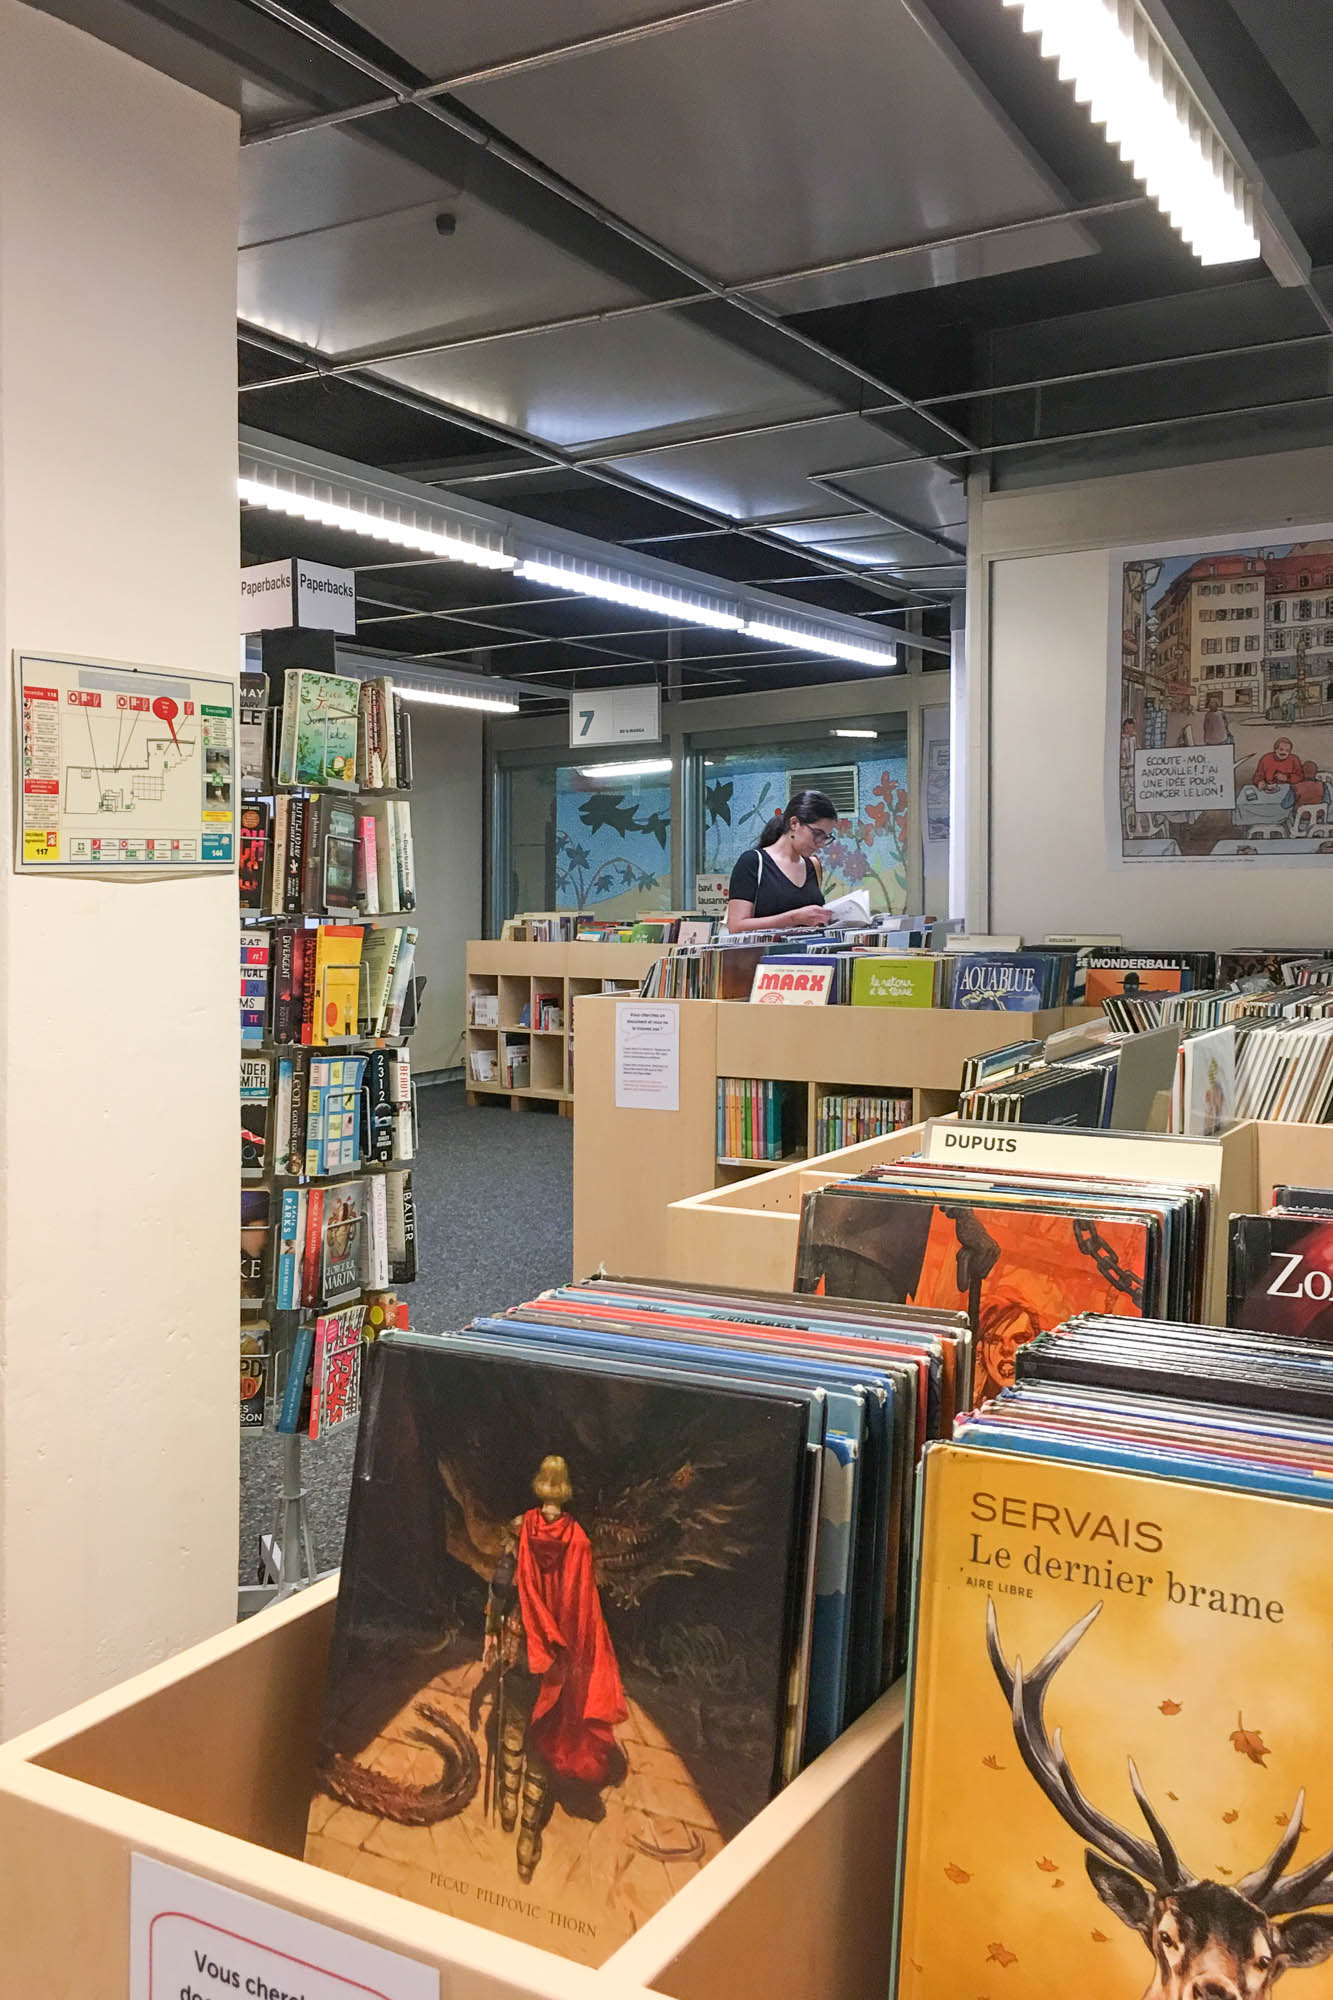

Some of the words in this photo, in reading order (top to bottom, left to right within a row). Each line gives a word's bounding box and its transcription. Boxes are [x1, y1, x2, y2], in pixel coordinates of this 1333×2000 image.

[241, 574, 291, 596] Paperbacks
[300, 573, 354, 597] Paperbacks
[579, 710, 595, 736] 7
[1143, 778, 1163, 788] UNE
[1189, 776, 1216, 786] POUR
[36, 848, 48, 856] 117
[281, 935, 292, 979] DIVERGENT
[1090, 958, 1180, 969] WONDERBALL
[757, 973, 826, 992] MARX
[960, 966, 1036, 992] AQUABLUE
[292, 1071, 304, 1108] Leon
[400, 1065, 409, 1099] BEAUTY
[291, 1110, 299, 1138] GOLDEN
[944, 1133, 1017, 1153] DUPUIS
[283, 1197, 293, 1233] PARKS
[324, 1270, 356, 1291] MARTIN
[1266, 1252, 1333, 1301] Zo
[970, 1491, 1164, 1553] SERVAIS
[966, 1576, 994, 1592] AIRE
[998, 1581, 1034, 1599] LIBRE
[968, 1533, 1011, 1569] Le
[1023, 1545, 1154, 1598] dernier
[1166, 1570, 1285, 1623] brame
[429, 1871, 470, 1896] PÉCAU
[475, 1887, 542, 1920] PILIPOVIC
[548, 1910, 598, 1939] THORN
[194, 1949, 241, 1989] Vous
